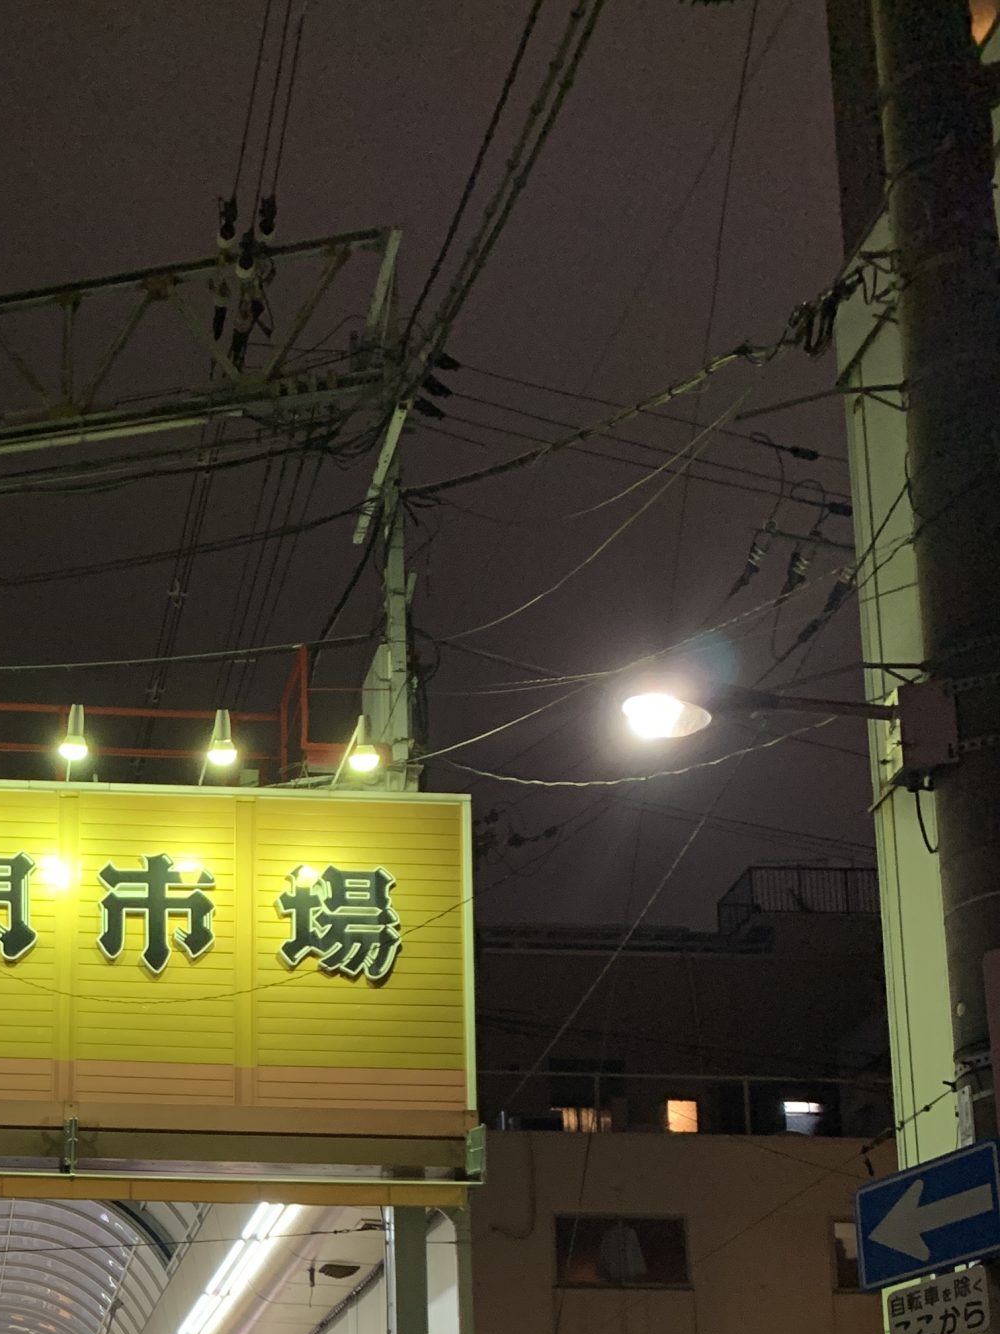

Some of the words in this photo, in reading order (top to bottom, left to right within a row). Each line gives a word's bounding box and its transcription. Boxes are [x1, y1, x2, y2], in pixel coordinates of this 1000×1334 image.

[891, 1275, 983, 1317] 自転車を除く
